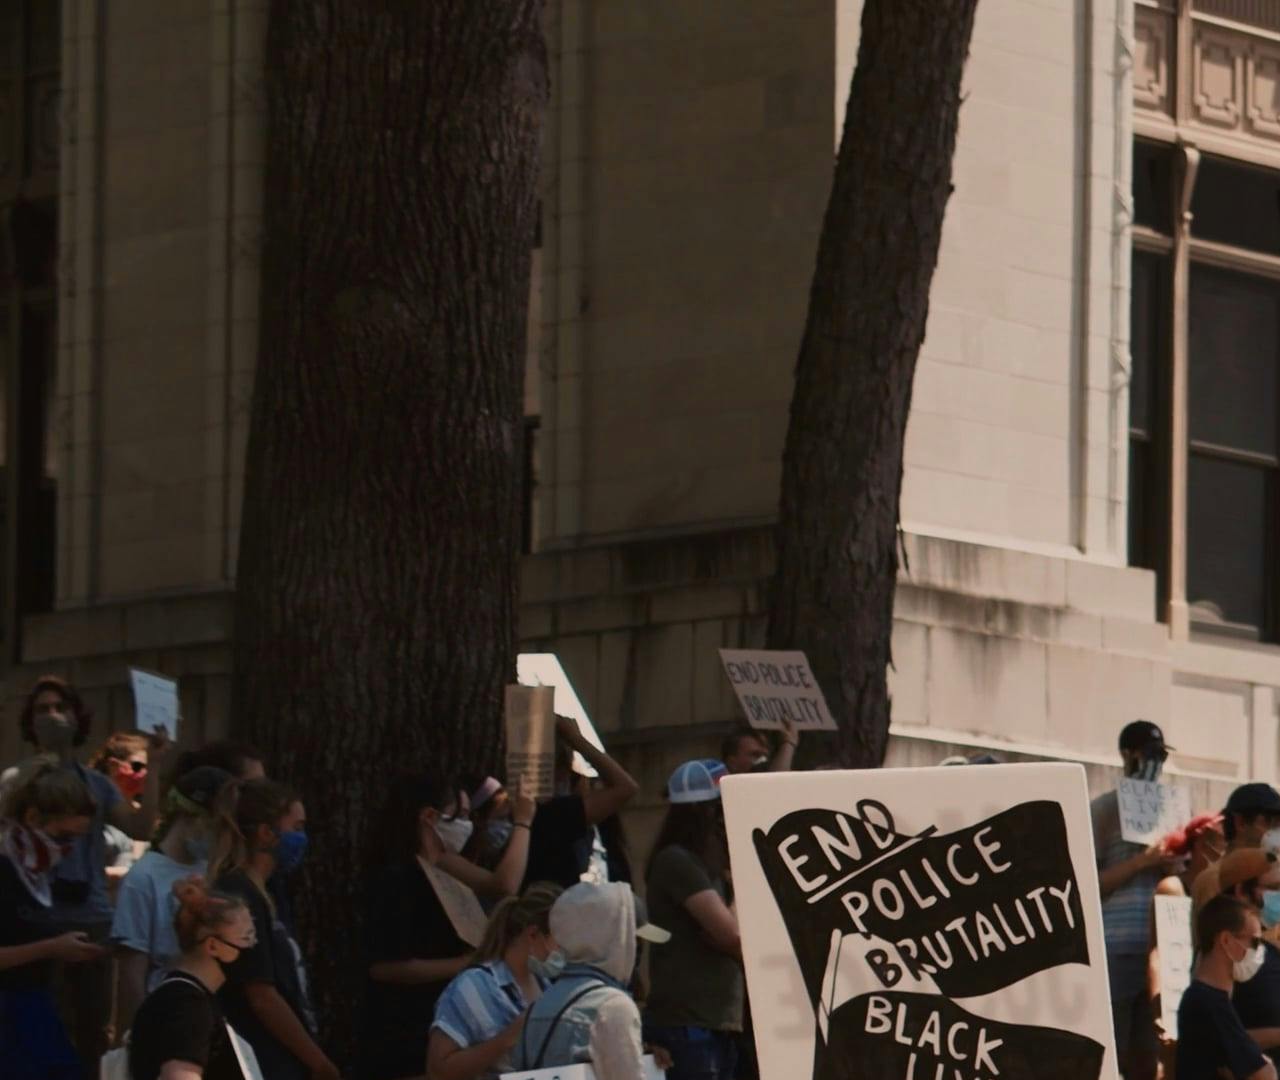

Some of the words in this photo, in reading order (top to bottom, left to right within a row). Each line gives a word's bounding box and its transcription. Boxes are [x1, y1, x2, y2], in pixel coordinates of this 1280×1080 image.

[777, 799, 896, 893] END
[840, 825, 1012, 933] POLICE
[864, 879, 1077, 989] BRUTALITY
[864, 995, 1004, 1076] BLACK
